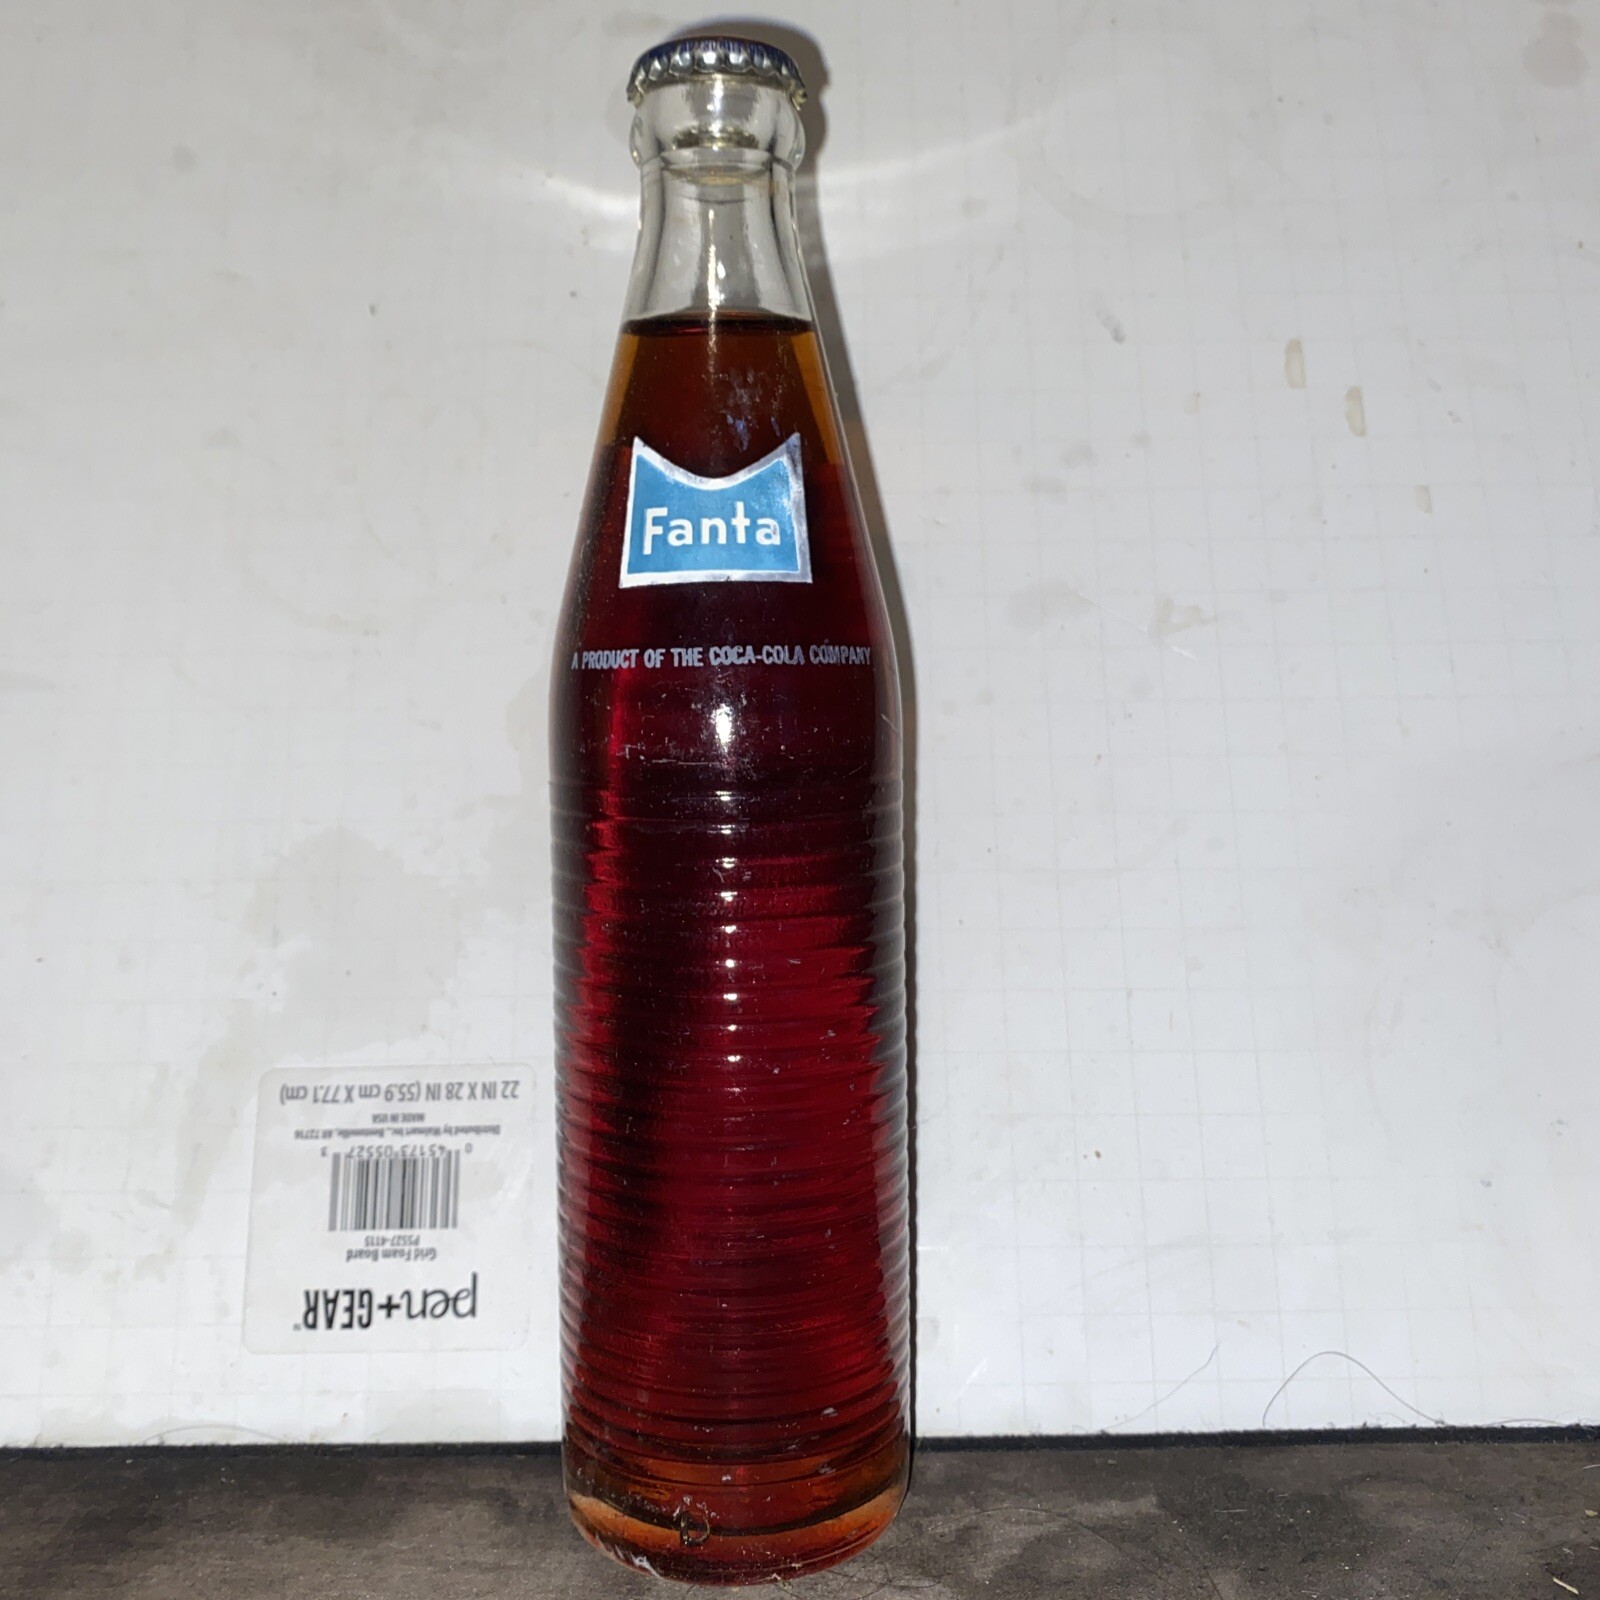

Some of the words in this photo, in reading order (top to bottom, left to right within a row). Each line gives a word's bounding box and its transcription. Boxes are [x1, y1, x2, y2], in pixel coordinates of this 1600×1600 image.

[643, 501, 781, 555] Fanta
[571, 651, 579, 670] A
[581, 649, 640, 670] PRODUCT
[643, 648, 665, 668] OF
[670, 647, 703, 667] THE
[709, 645, 805, 666] COCA-COLA
[809, 645, 871, 666] COMPANY
[280, 1083, 308, 1106] cm)
[313, 1084, 340, 1104] 77.1
[344, 1084, 355, 1104] X
[358, 1084, 381, 1099] cm
[384, 1080, 421, 1103] (55.9
[425, 1082, 441, 1102] IN
[445, 1082, 464, 1101] 28
[467, 1081, 478, 1100] X
[481, 1081, 497, 1100] IN
[501, 1080, 519, 1099] 22
[372, 1113, 388, 1123] USA
[390, 1112, 399, 1122] IN
[402, 1112, 425, 1122] MADE
[346, 1248, 379, 1263] Board
[381, 1248, 411, 1261] Foam
[414, 1247, 437, 1261] Grid
